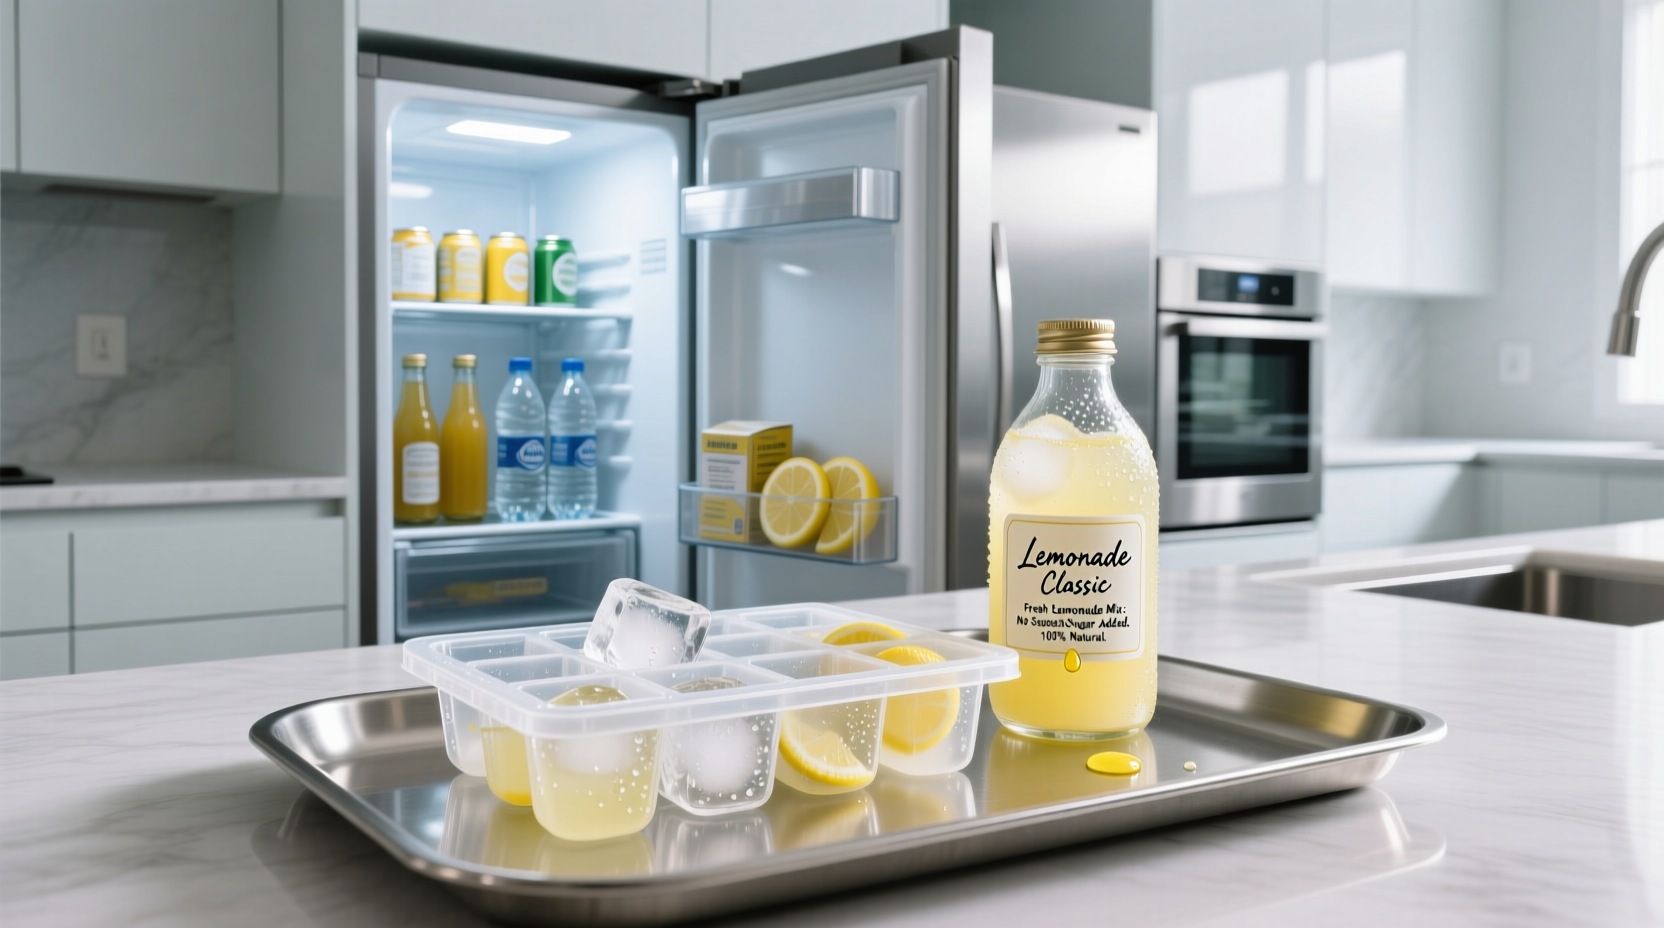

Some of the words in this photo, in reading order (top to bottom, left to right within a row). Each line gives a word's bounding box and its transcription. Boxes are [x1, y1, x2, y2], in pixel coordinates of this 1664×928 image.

[1017, 536, 1132, 569] Lemonade
[1041, 570, 1112, 596] Classic
[1017, 615, 1029, 626] No
[1041, 631, 1066, 642] 100%
